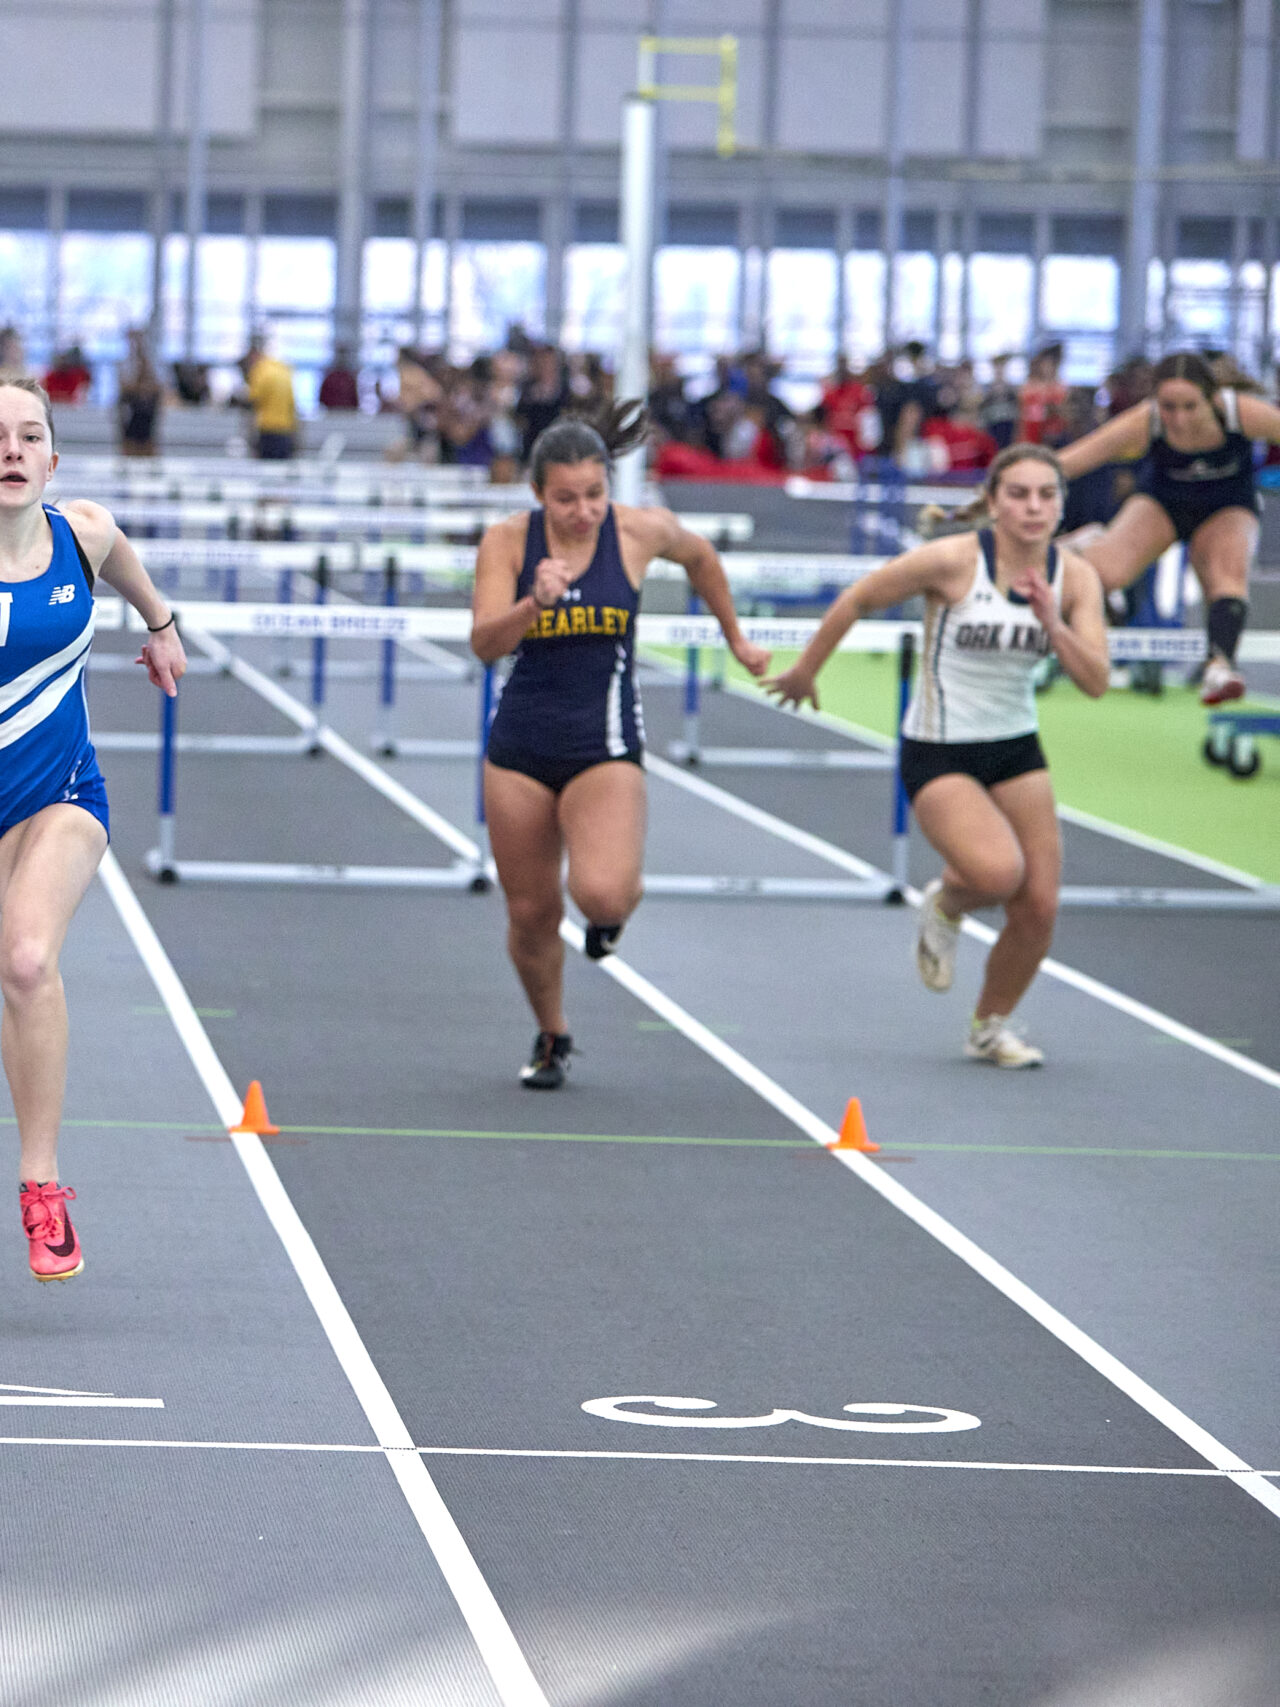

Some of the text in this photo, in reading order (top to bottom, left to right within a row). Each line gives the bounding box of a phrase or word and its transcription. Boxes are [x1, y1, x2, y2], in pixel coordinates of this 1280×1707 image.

[524, 605, 630, 639] EARLEY
[955, 622, 1004, 651] OAK
[581, 1395, 982, 1433] 3
